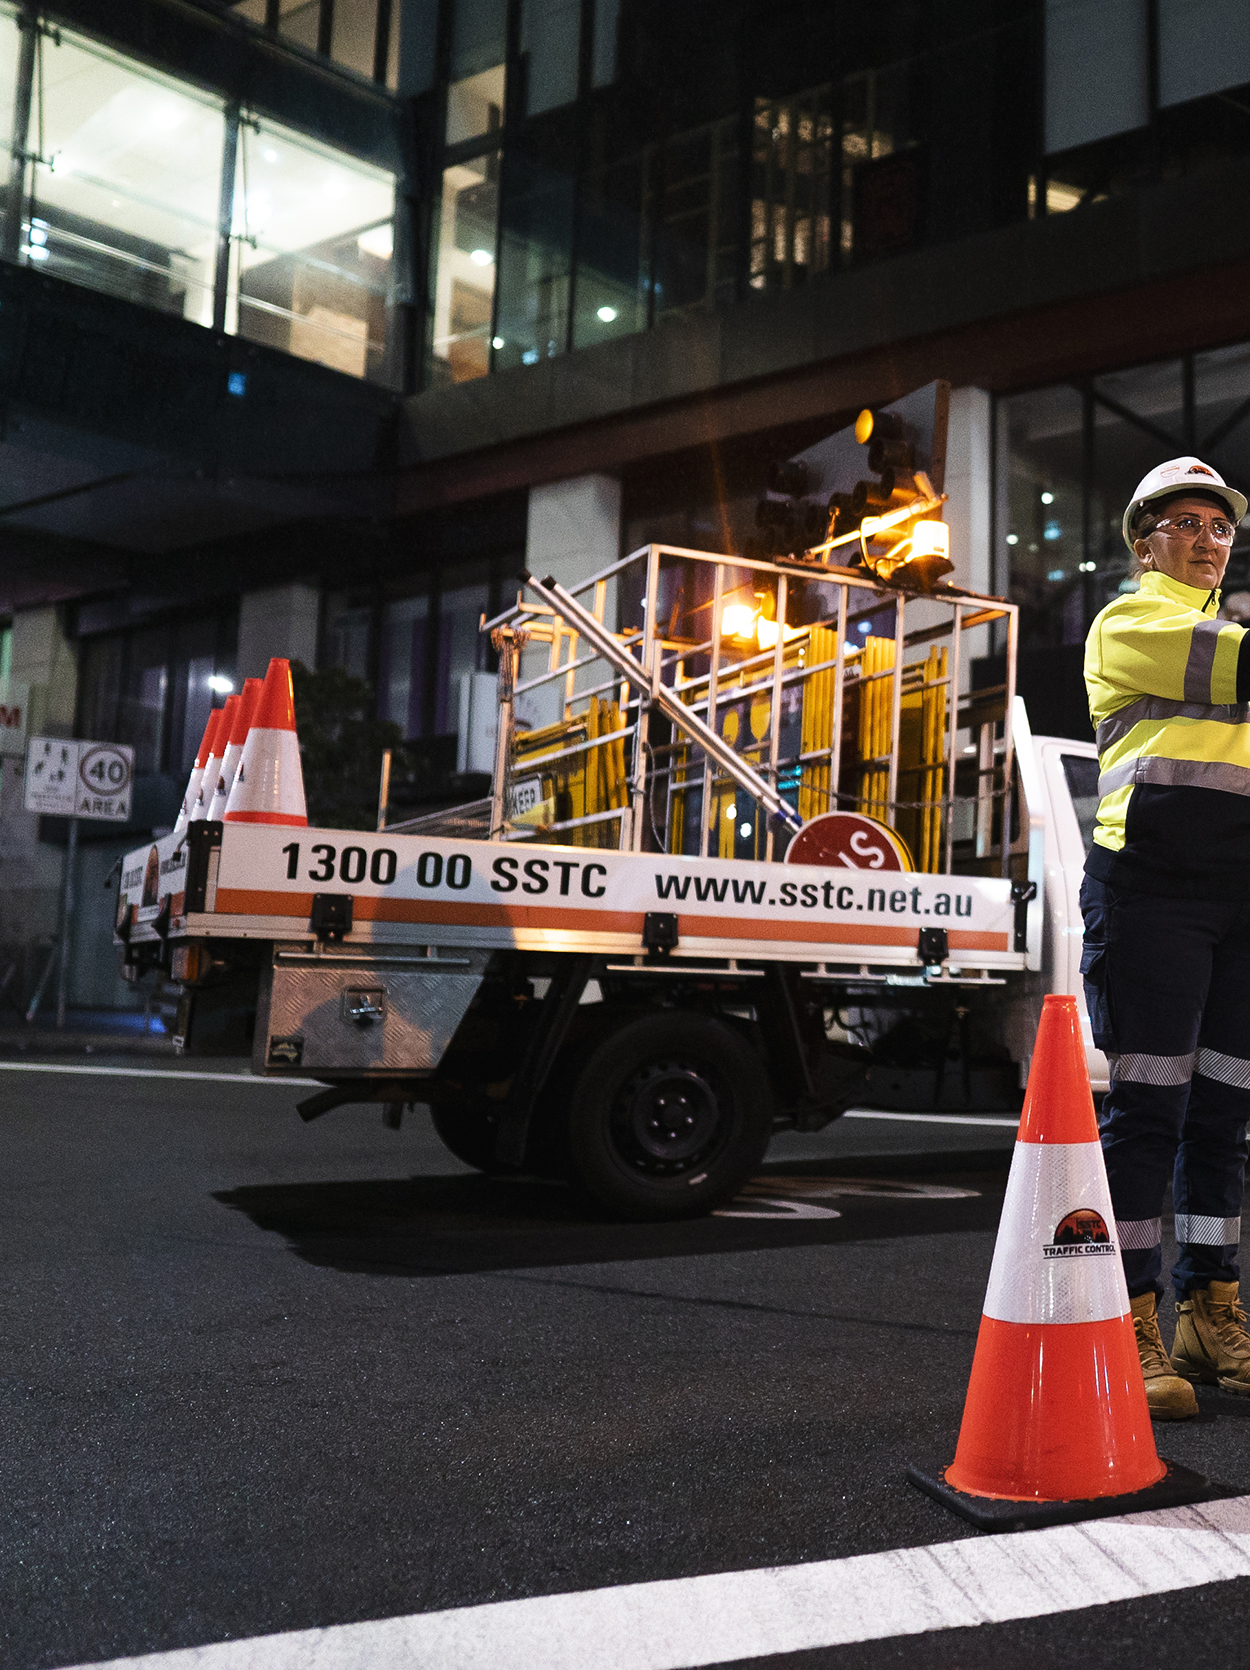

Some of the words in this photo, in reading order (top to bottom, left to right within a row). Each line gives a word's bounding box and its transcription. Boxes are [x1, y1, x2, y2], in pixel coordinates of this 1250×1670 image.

[89, 758, 124, 784] 40
[79, 797, 127, 815] AREA
[282, 842, 397, 885] 1300
[416, 852, 472, 890] 00
[490, 857, 607, 898] SSTC
[655, 873, 973, 918] www.sstc.net.au
[1043, 1245, 1083, 1256] TRAFFIC
